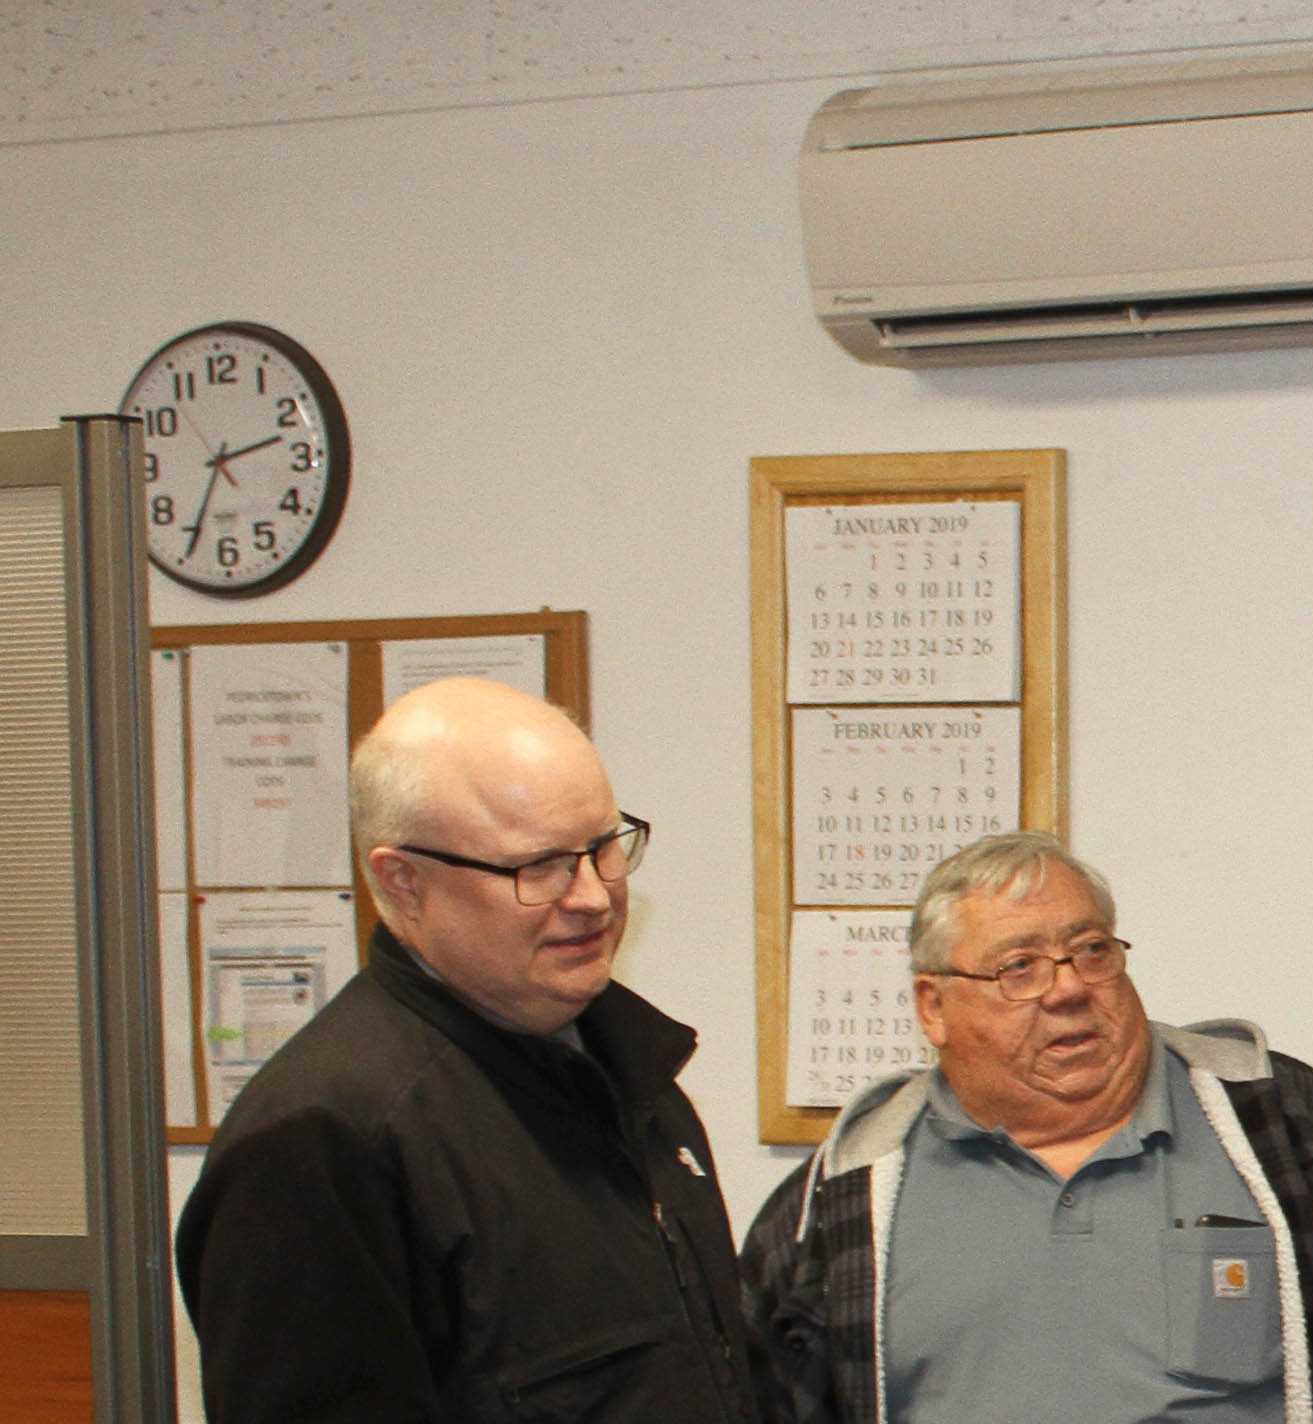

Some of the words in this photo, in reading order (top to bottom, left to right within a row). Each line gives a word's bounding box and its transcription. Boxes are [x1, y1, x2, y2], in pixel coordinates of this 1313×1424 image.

[206, 354, 237, 385] 12
[173, 372, 195, 401] 11
[256, 367, 264, 394] 1
[146, 406, 177, 437] 10
[277, 398, 297, 428] 2
[290, 442, 312, 472] 3
[152, 496, 174, 525] 8
[278, 487, 301, 515] 4
[254, 521, 276, 551] 5
[834, 518, 920, 535] JANUARY
[929, 516, 969, 534] 2019
[217, 536, 239, 567] 6
[896, 553, 906, 571] 2
[924, 552, 934, 570] 3
[950, 552, 961, 569] 4
[979, 551, 988, 569] 5
[815, 585, 826, 601] 6
[843, 582, 852, 598] 7
[869, 583, 879, 599] 8
[895, 582, 907, 598] 9
[921, 582, 939, 598] 10
[947, 581, 963, 598] 11
[975, 580, 993, 598] 12
[812, 612, 830, 629] 13
[839, 612, 857, 629] 14
[866, 612, 884, 628] 15
[893, 611, 912, 627] 16
[921, 610, 938, 627] 17
[947, 610, 965, 627] 18
[975, 609, 993, 625] 19
[810, 641, 830, 659] 20
[838, 640, 855, 658] 21
[864, 640, 884, 657] 22
[891, 639, 911, 657] 23
[919, 639, 938, 656] 24
[945, 638, 964, 656] 25
[972, 638, 992, 656] 26
[810, 669, 829, 687] 27
[837, 669, 855, 686] 28
[863, 669, 883, 686] 29
[893, 668, 911, 684] 30
[920, 668, 936, 685] 31
[834, 723, 935, 739] FEBRUARY
[943, 722, 982, 739] 2019
[986, 757, 995, 775] 2
[821, 786, 832, 803] 3
[848, 787, 859, 803] 4
[877, 786, 886, 803] 5
[903, 787, 914, 804] 6
[931, 786, 941, 802] 7
[959, 787, 968, 804] 8
[985, 786, 996, 802] 9
[818, 816, 837, 832] 10
[847, 816, 863, 832] 11
[874, 815, 891, 833] 12
[900, 815, 919, 832] 13
[929, 815, 946, 832] 14
[956, 815, 973, 832] 15
[983, 815, 999, 832] 16
[818, 844, 837, 860] 17
[847, 844, 865, 861] 18
[874, 844, 892, 861] 19
[901, 844, 920, 861] 20
[817, 873, 837, 890] 24
[846, 872, 864, 890] 25
[873, 873, 892, 890] 26
[901, 873, 919, 890] 27
